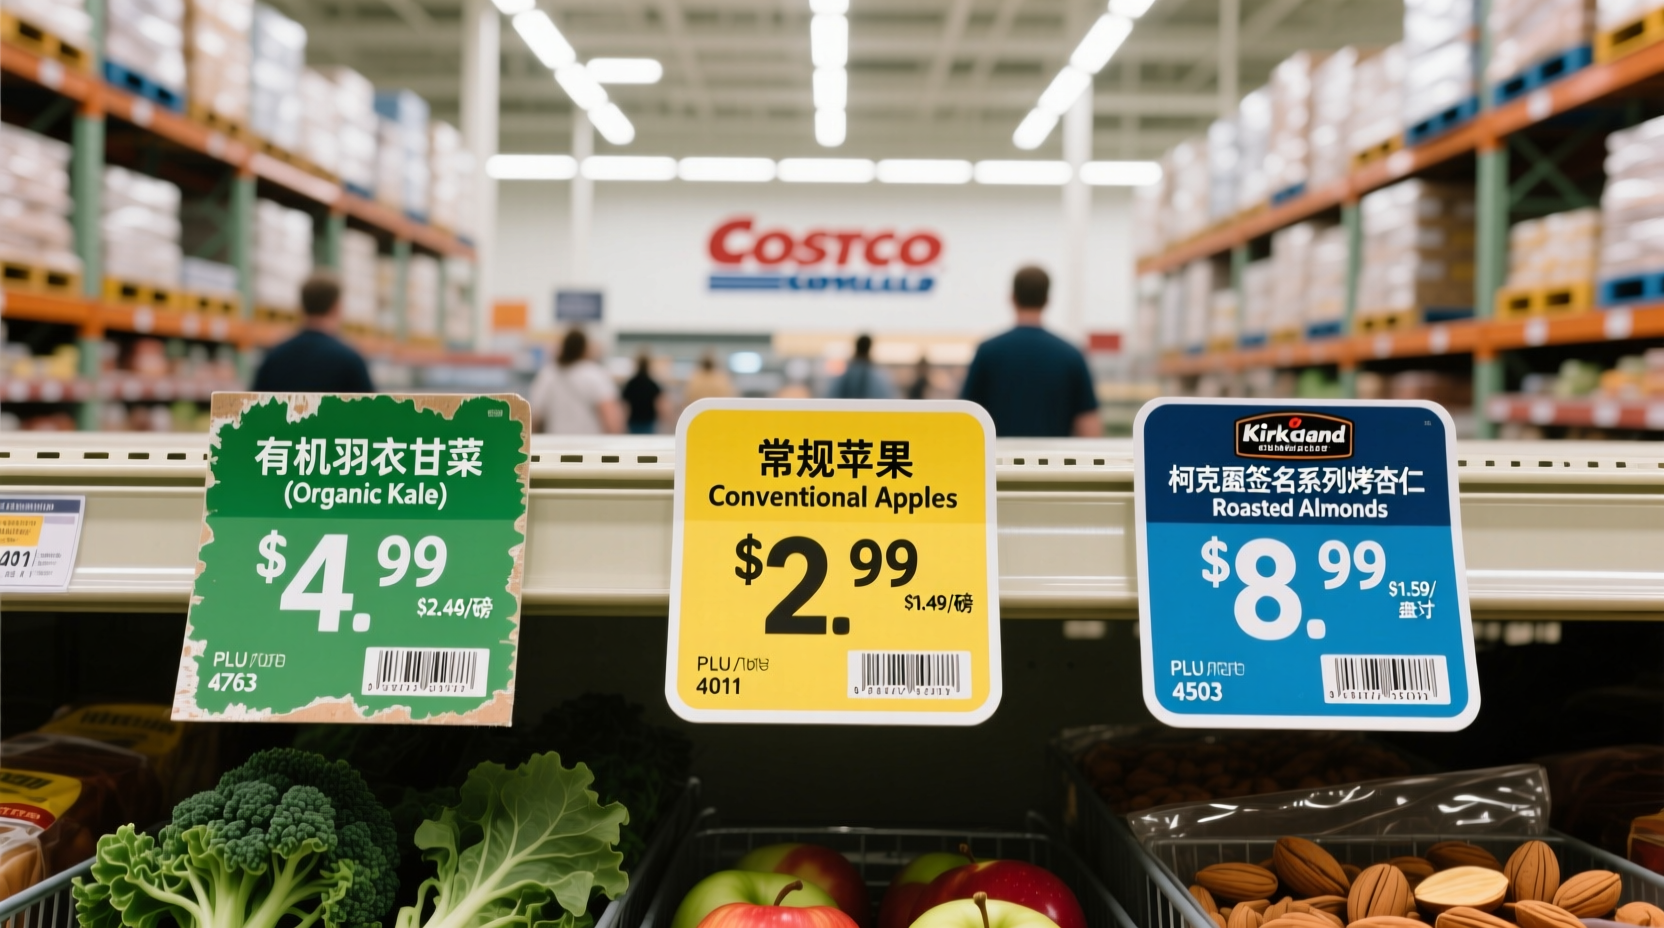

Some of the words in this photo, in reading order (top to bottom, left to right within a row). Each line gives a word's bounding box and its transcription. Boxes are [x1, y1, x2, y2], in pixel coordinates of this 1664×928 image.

[708, 215, 943, 267] COSTCO
[255, 436, 484, 478] 有机羽衣甘菜
[758, 438, 914, 479] 常规苹果
[284, 480, 382, 510] (Organic
[387, 481, 448, 511] Kale)
[708, 484, 868, 509] Conventional
[874, 485, 958, 515] Apples
[1212, 497, 1294, 518] Roasted
[1298, 497, 1389, 519] Almonds
[208, 672, 258, 693] 4763
[696, 677, 742, 695] 4011
[1171, 681, 1223, 702] 4503
